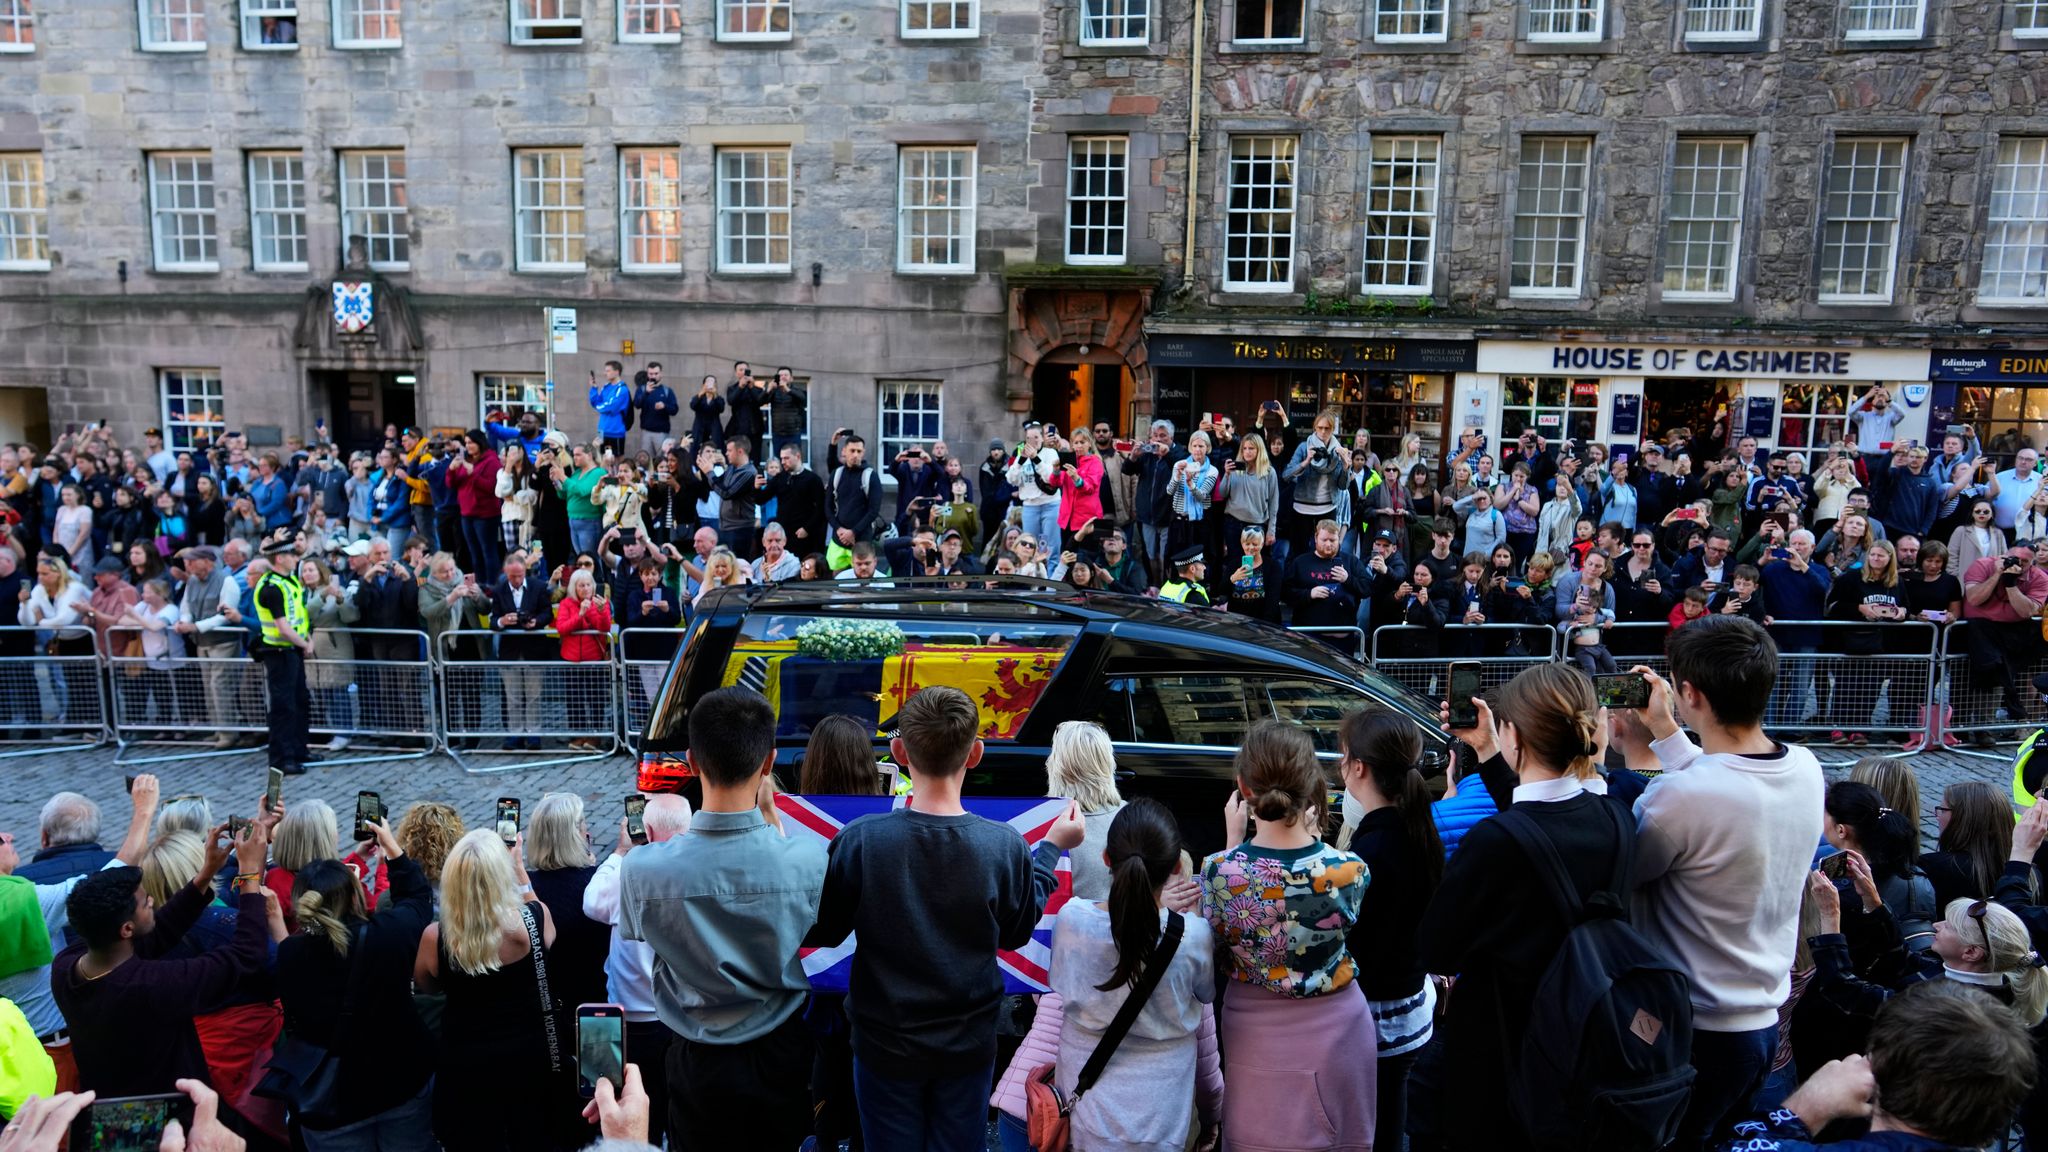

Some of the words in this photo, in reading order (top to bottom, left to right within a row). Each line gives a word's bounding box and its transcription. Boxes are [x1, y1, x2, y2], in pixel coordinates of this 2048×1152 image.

[1231, 341, 1268, 359] The
[1274, 341, 1344, 364] Whisky
[1352, 343, 1396, 360] Trail
[1553, 347, 1644, 369] HOUSE
[1652, 349, 1688, 370] OF
[1695, 350, 1851, 374] CASHMERE
[1942, 358, 1987, 368] Edinburgh
[2000, 358, 2048, 373] EDIN
